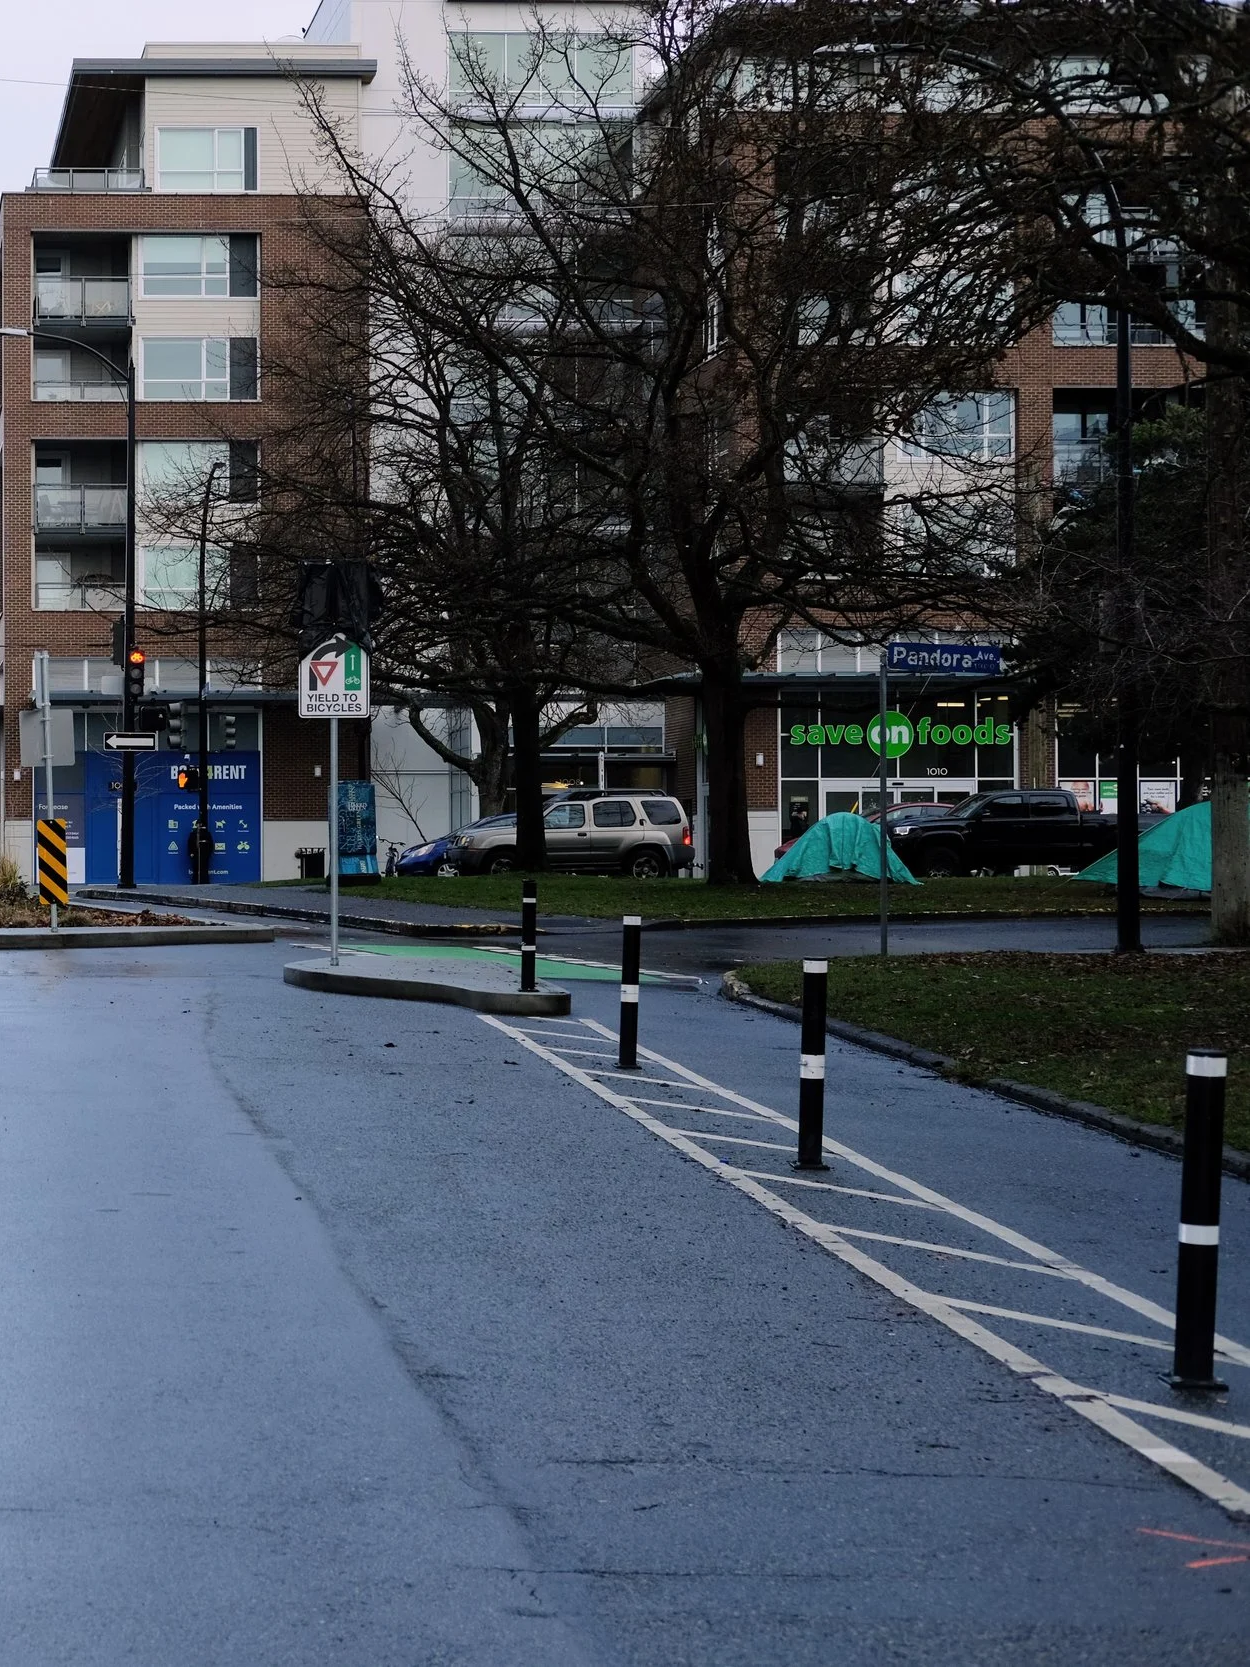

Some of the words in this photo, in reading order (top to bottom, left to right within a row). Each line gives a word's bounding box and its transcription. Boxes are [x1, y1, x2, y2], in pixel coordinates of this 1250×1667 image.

[893, 646, 973, 668] Pandora
[977, 650, 997, 661] Ave.
[307, 693, 340, 702] YIELD
[343, 693, 358, 702] TO
[306, 703, 362, 712] BICYCLES
[790, 724, 863, 745] save
[870, 725, 910, 744] on
[917, 717, 1011, 745] foods
[926, 767, 948, 776] 1010
